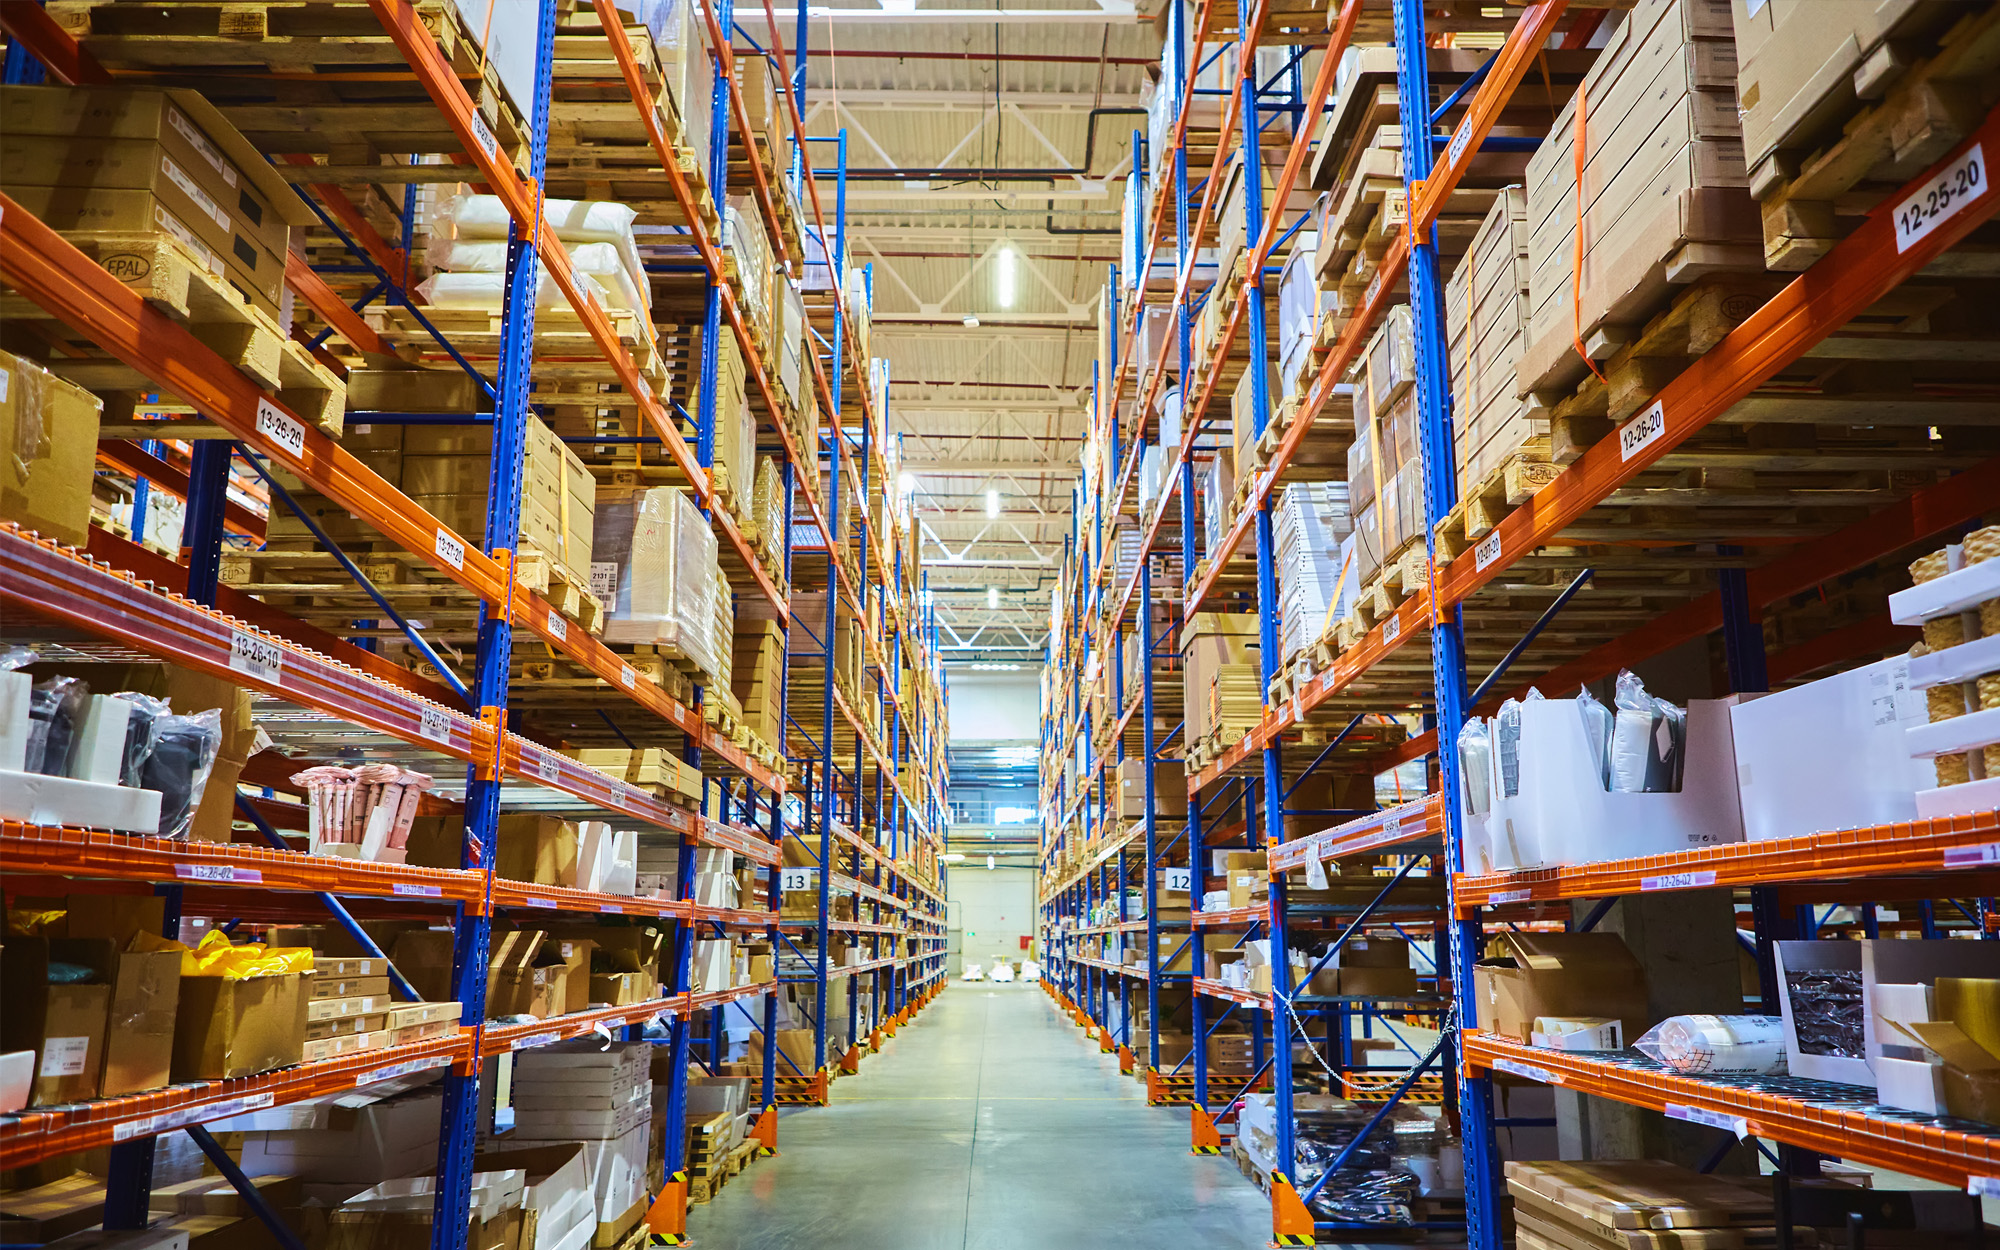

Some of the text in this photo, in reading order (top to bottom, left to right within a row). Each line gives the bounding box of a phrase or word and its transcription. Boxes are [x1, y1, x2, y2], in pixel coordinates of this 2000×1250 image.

[1900, 160, 1980, 236] 12-25-20
[108, 260, 144, 276] EPAL
[260, 408, 302, 449] 13-26-20
[1623, 410, 1662, 451] 12-26-20
[438, 535, 463, 564] 13-27-20
[1477, 537, 1500, 564] 12-27-20
[592, 572, 607, 580] 2131
[236, 636, 279, 669] 13-26-10
[423, 710, 449, 732] 13-27-10
[786, 875, 805, 889] 13
[1171, 875, 1190, 889] 12
[1660, 874, 1692, 887] 12-26-02
